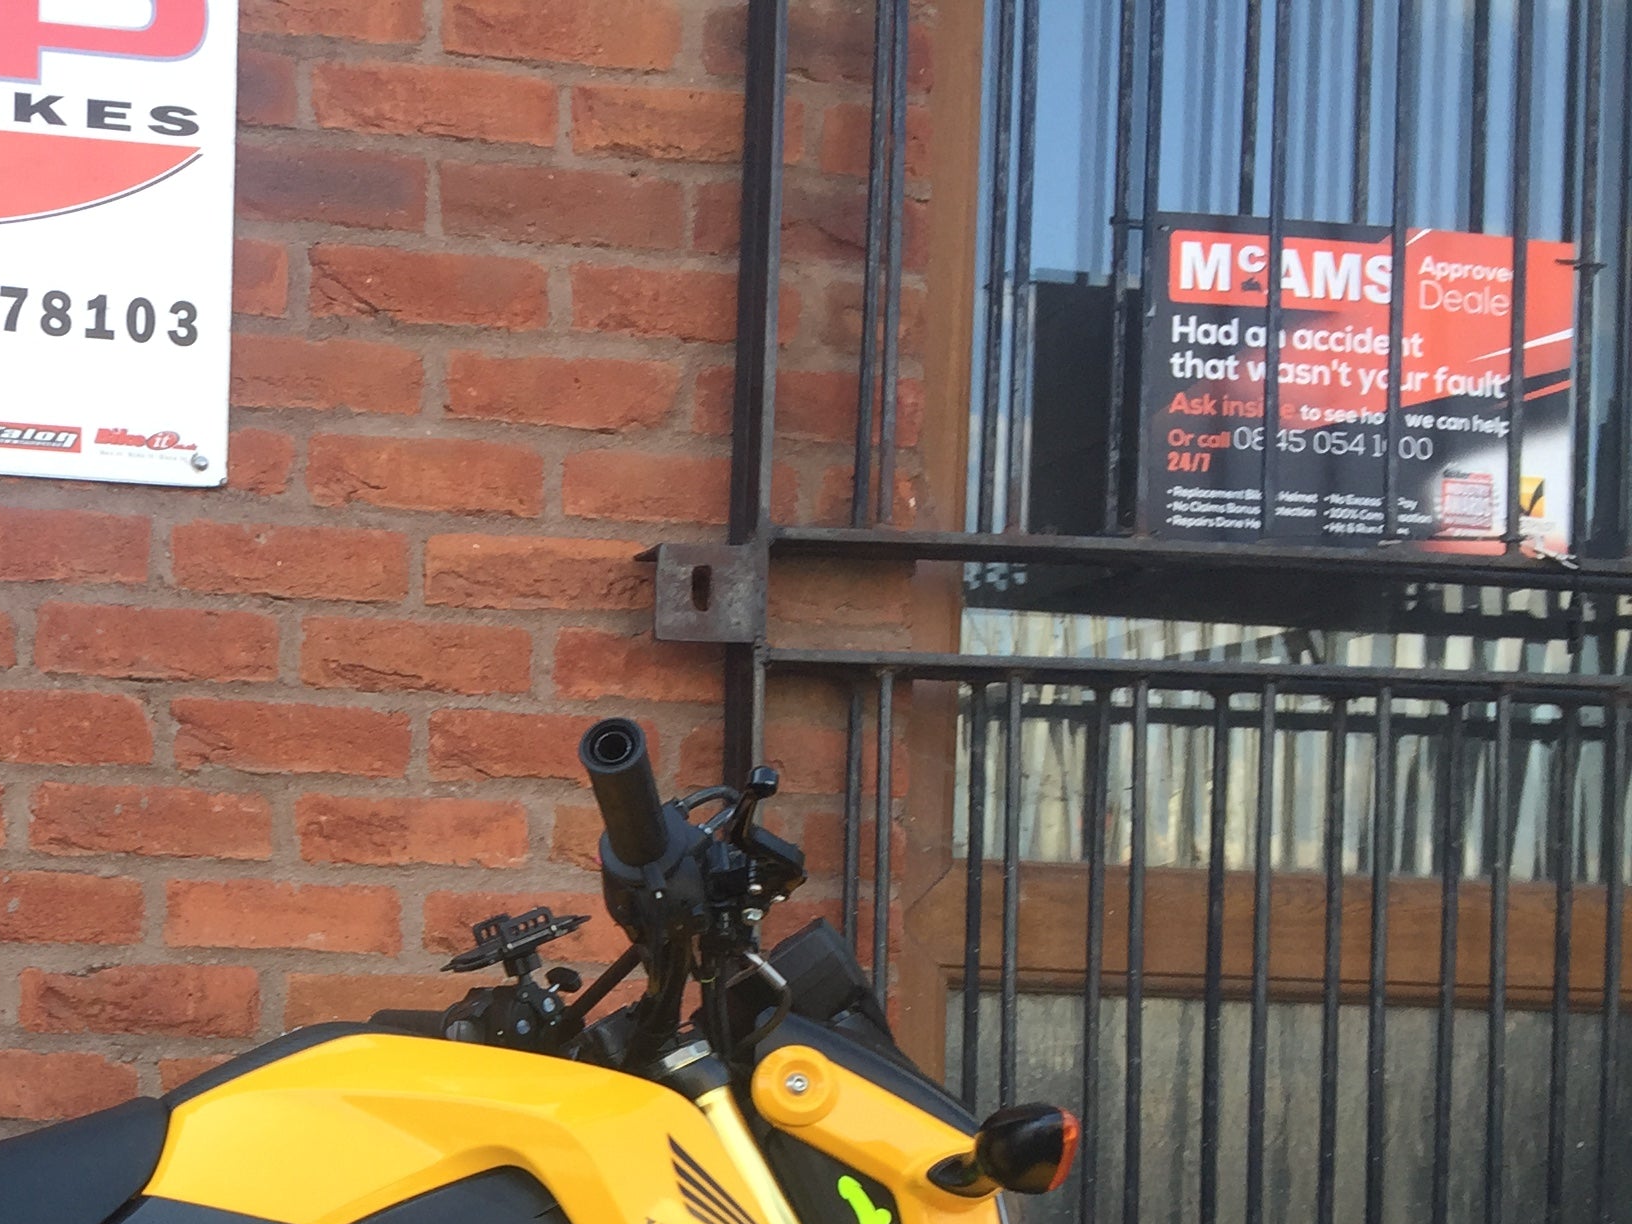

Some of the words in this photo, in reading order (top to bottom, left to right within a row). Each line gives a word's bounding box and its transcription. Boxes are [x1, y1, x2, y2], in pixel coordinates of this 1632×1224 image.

[1419, 255, 1514, 283] Approve
[1419, 280, 1510, 316] Deale
[1172, 314, 1240, 347] Had
[1170, 350, 1240, 381] that
[1169, 391, 1217, 416] Ask
[1222, 395, 1297, 419] insie
[1300, 404, 1321, 422] to
[1324, 408, 1358, 424] see
[1359, 407, 1388, 426] ho
[1404, 412, 1435, 429] we
[1436, 415, 1470, 431] can
[1168, 428, 1194, 447] Or
[1197, 431, 1231, 449] call
[1312, 430, 1367, 456] 054
[1371, 433, 1434, 461] 100
[1167, 451, 1211, 473] 24/7
